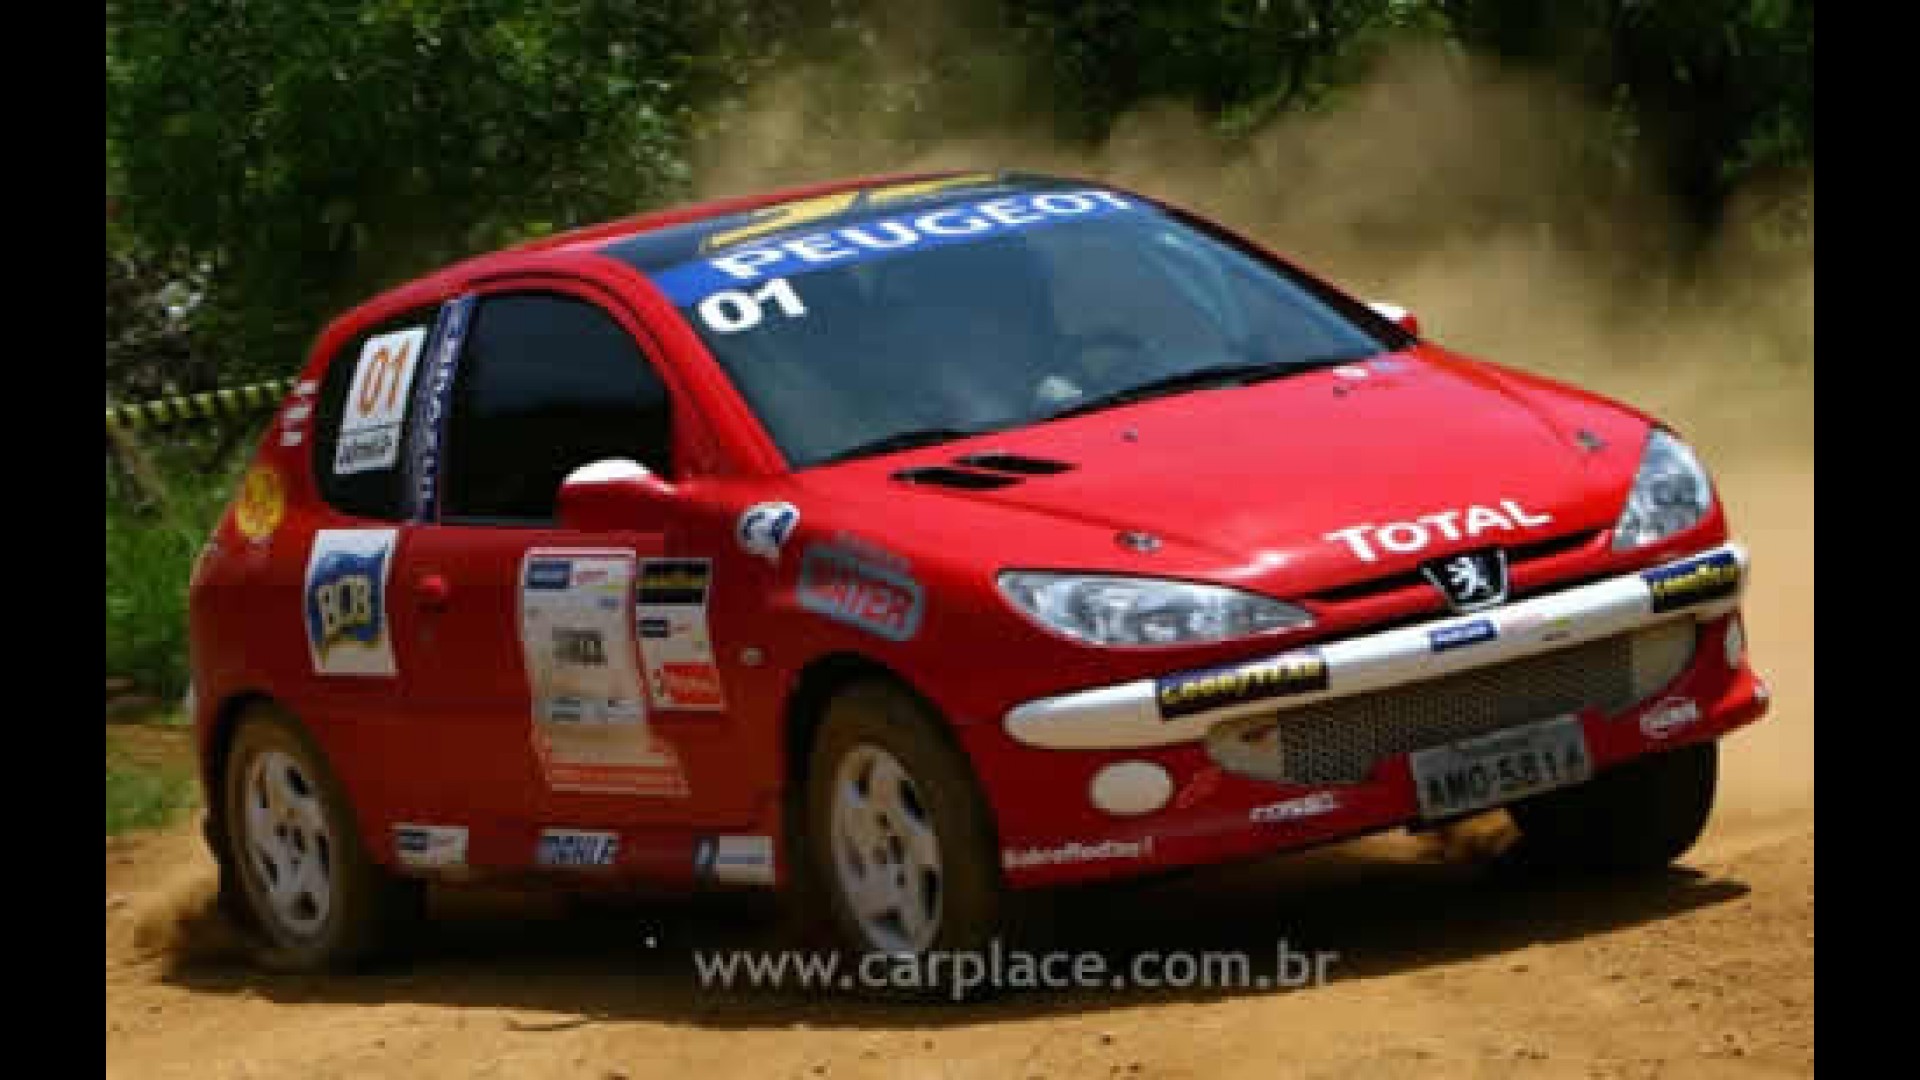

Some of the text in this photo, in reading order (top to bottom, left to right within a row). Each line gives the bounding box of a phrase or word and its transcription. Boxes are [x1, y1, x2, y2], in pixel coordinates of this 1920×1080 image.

[711, 189, 1135, 279] PEUGEOT
[699, 277, 808, 332] 01
[361, 341, 411, 417] 01
[1323, 499, 1554, 562] TOTAL
